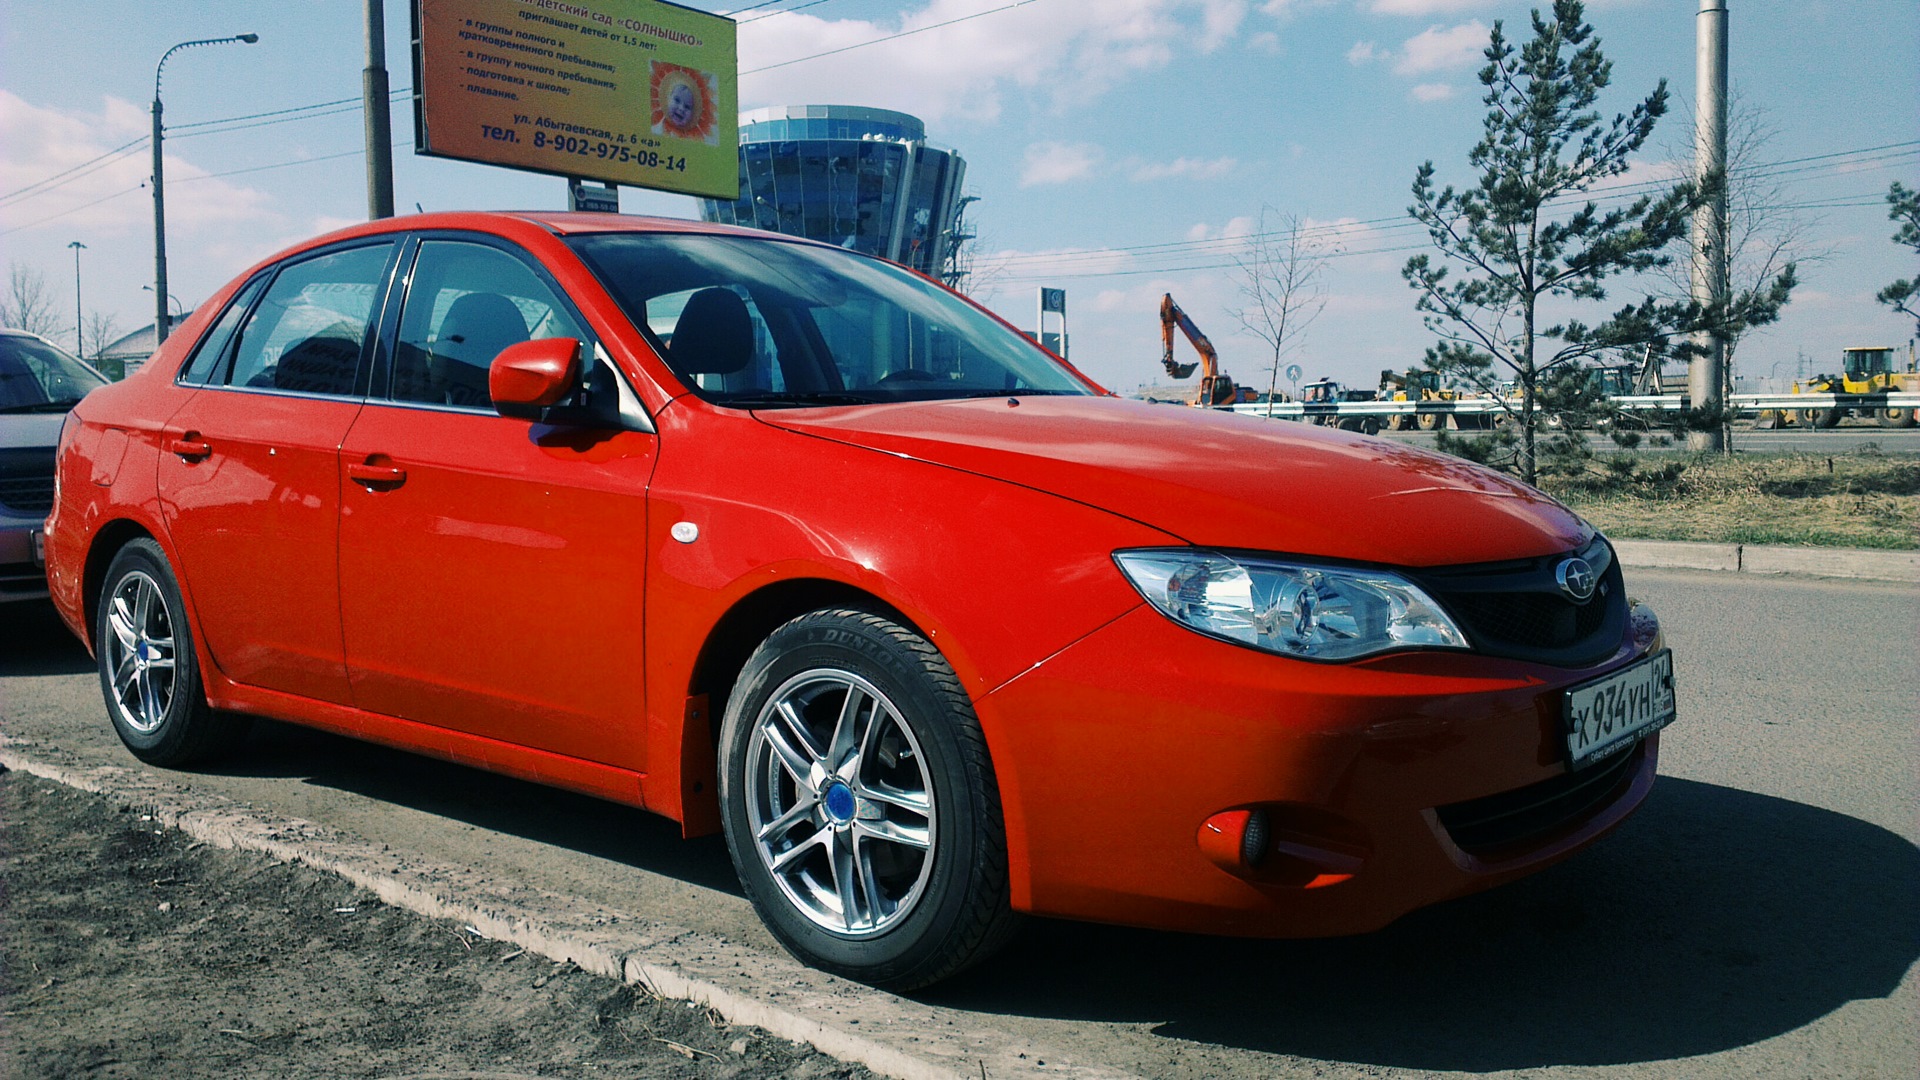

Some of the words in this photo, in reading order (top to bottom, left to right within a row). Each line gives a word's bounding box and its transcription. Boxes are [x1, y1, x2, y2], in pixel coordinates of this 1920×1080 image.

[475, 20, 513, 36] группы
[515, 30, 556, 46] полного
[518, 10, 578, 31] приглашает
[580, 26, 608, 39] детей
[610, 33, 621, 41] от
[623, 35, 637, 46] 1,5
[537, 0, 588, 17] детский
[592, 12, 612, 26] сад
[618, 19, 703, 46] «СОЛНЫШКО»
[459, 30, 554, 58] кратковременного
[476, 52, 511, 68] группу
[514, 60, 554, 76] ночного
[467, 66, 524, 85] подготовка
[536, 81, 571, 96] школе;
[467, 84, 519, 101] плавание.
[513, 114, 531, 125] ул.
[535, 116, 614, 141] Абытаевская,
[616, 134, 627, 143] д.
[630, 133, 637, 144] 6
[641, 138, 661, 148] «а»
[481, 125, 520, 144] тел.
[533, 131, 686, 172] 8-902-975-08-14
